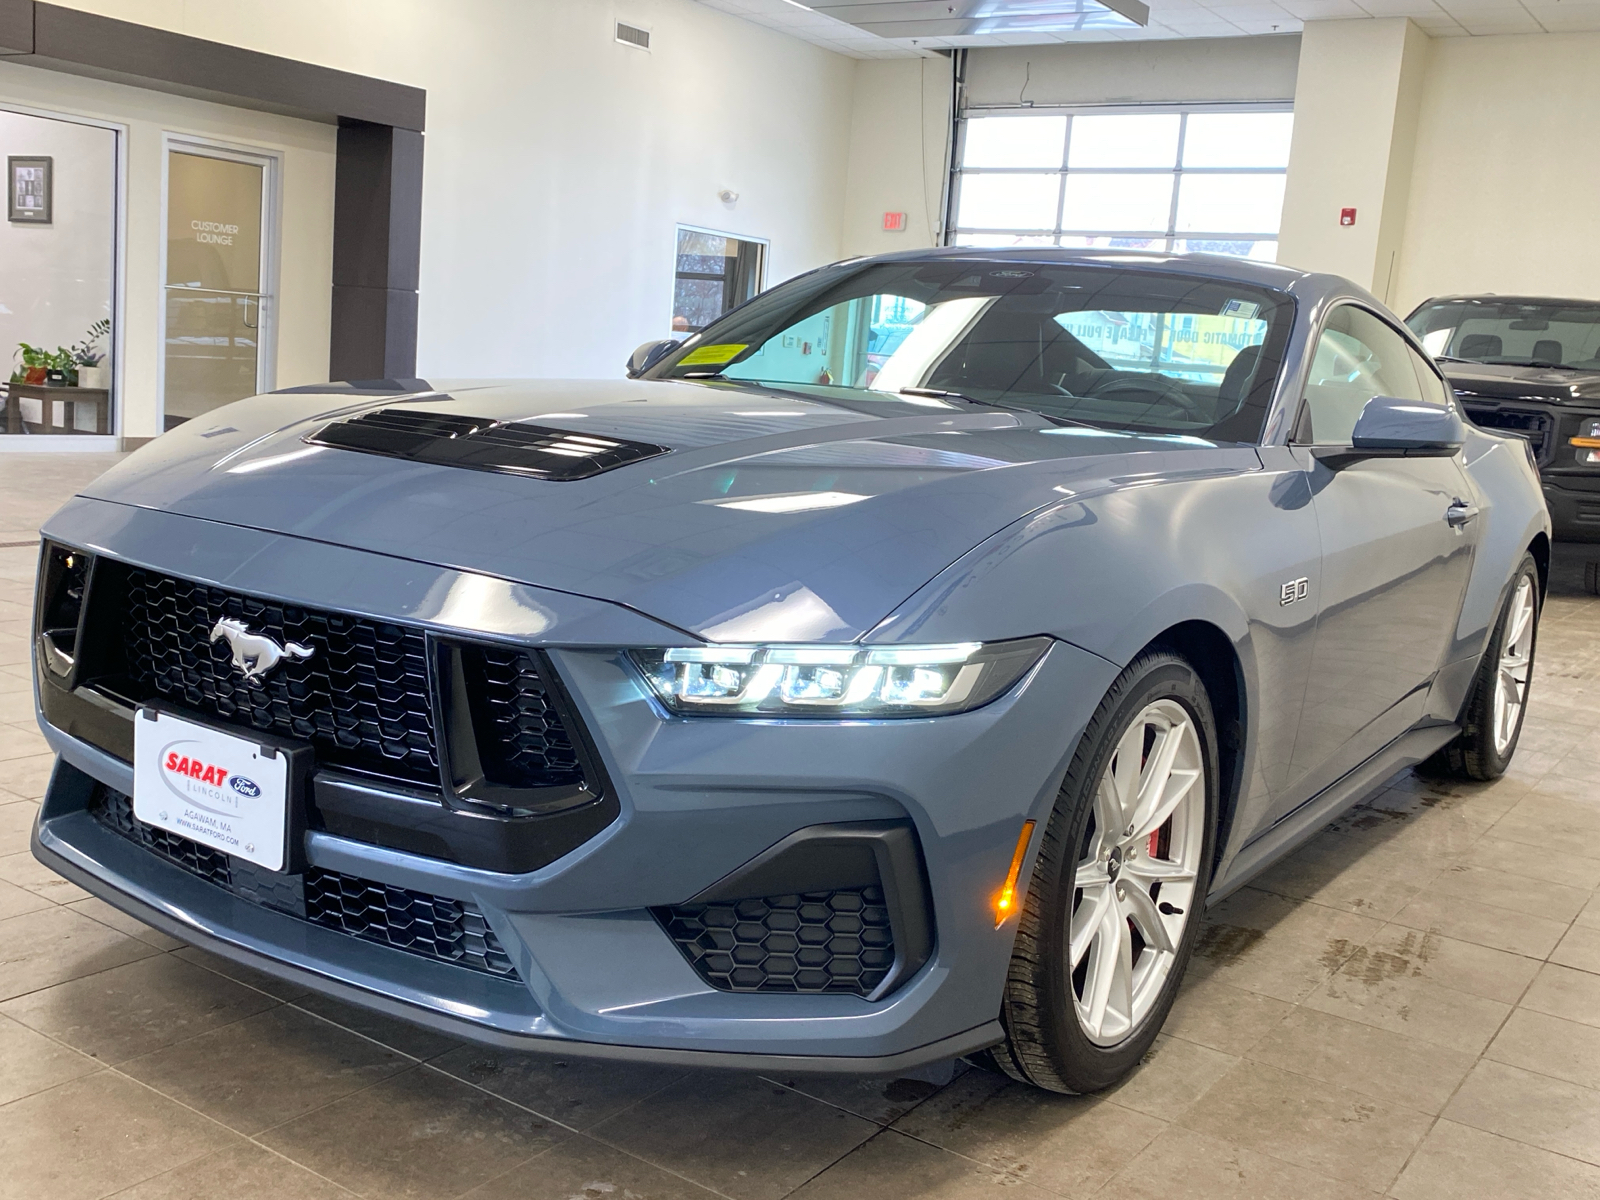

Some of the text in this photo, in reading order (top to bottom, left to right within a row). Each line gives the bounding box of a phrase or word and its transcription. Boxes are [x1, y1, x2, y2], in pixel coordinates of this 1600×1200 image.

[191, 220, 239, 235] CUSTOMER
[196, 232, 233, 246] LOUNGE
[165, 752, 228, 787] SARAT
[192, 784, 232, 804] LINCOLN
[233, 778, 257, 797] Ford
[176, 816, 240, 847] WWW.SARATFORD.COM
[219, 821, 232, 833] MA
